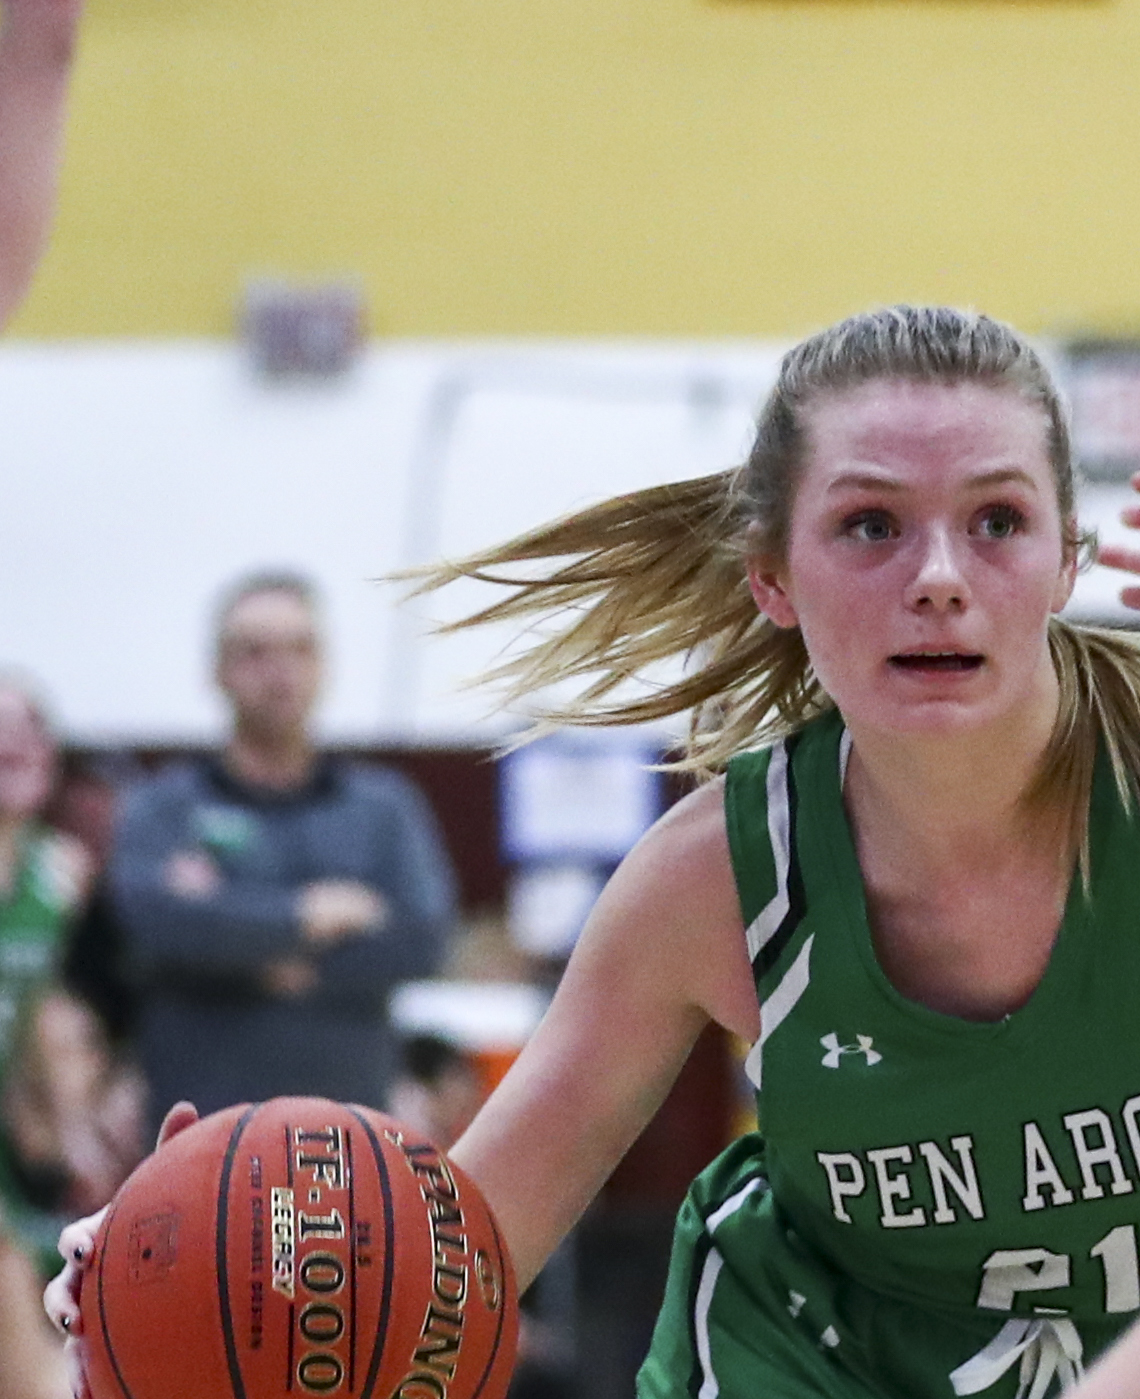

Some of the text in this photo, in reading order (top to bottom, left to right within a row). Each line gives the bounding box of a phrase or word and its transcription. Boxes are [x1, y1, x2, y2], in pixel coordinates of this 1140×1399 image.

[816, 1135, 986, 1230] PEN
[270, 1187, 294, 1299] LEGACY
[296, 1125, 345, 1394] TF-1000
